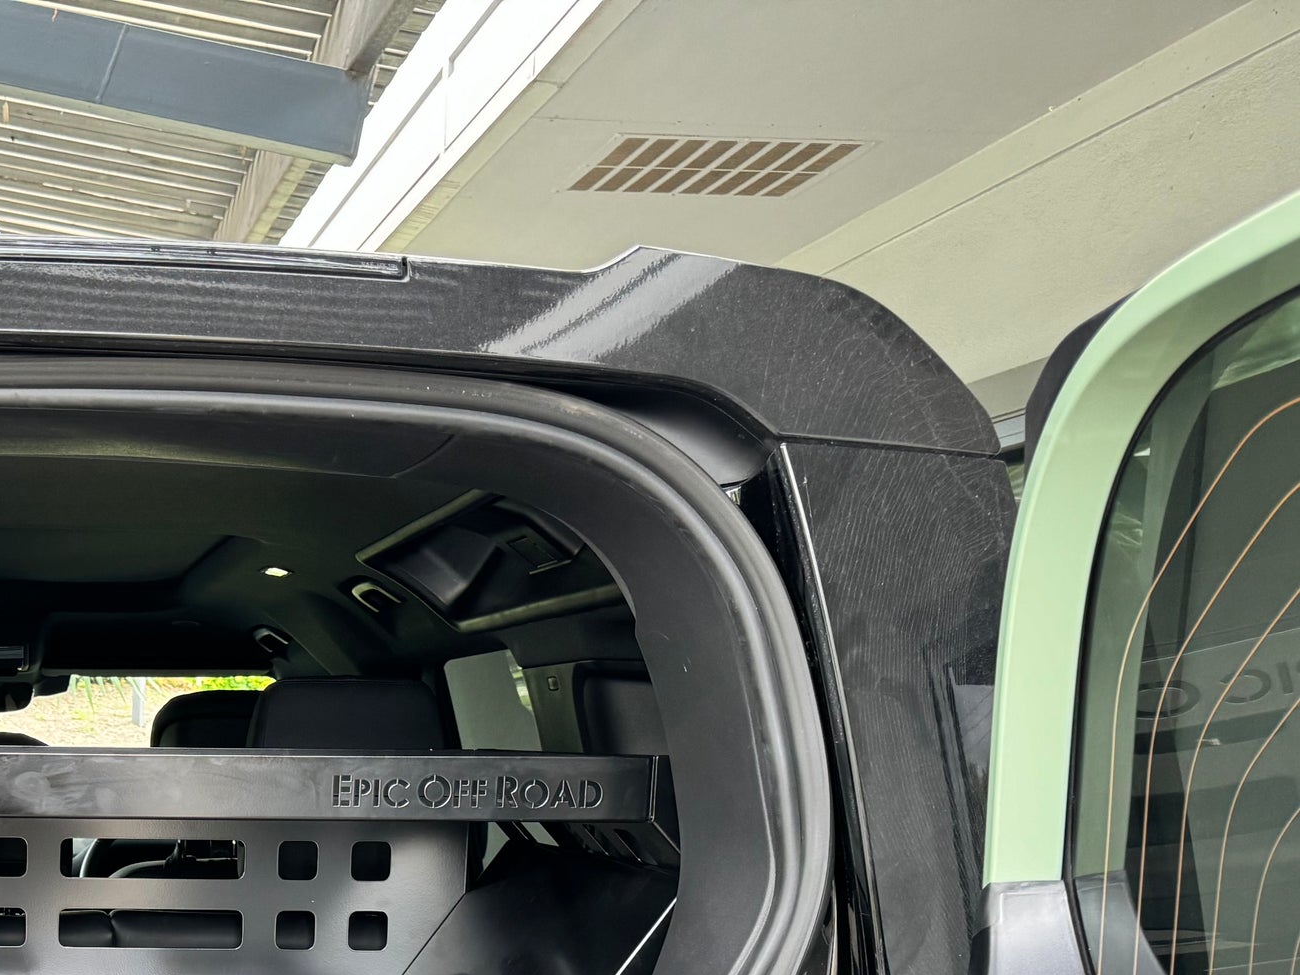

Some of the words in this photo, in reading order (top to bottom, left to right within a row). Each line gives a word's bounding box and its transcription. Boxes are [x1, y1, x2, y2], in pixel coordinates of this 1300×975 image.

[332, 775, 410, 808] EPIC
[417, 774, 488, 808] OFF
[496, 775, 604, 808] ROAD
